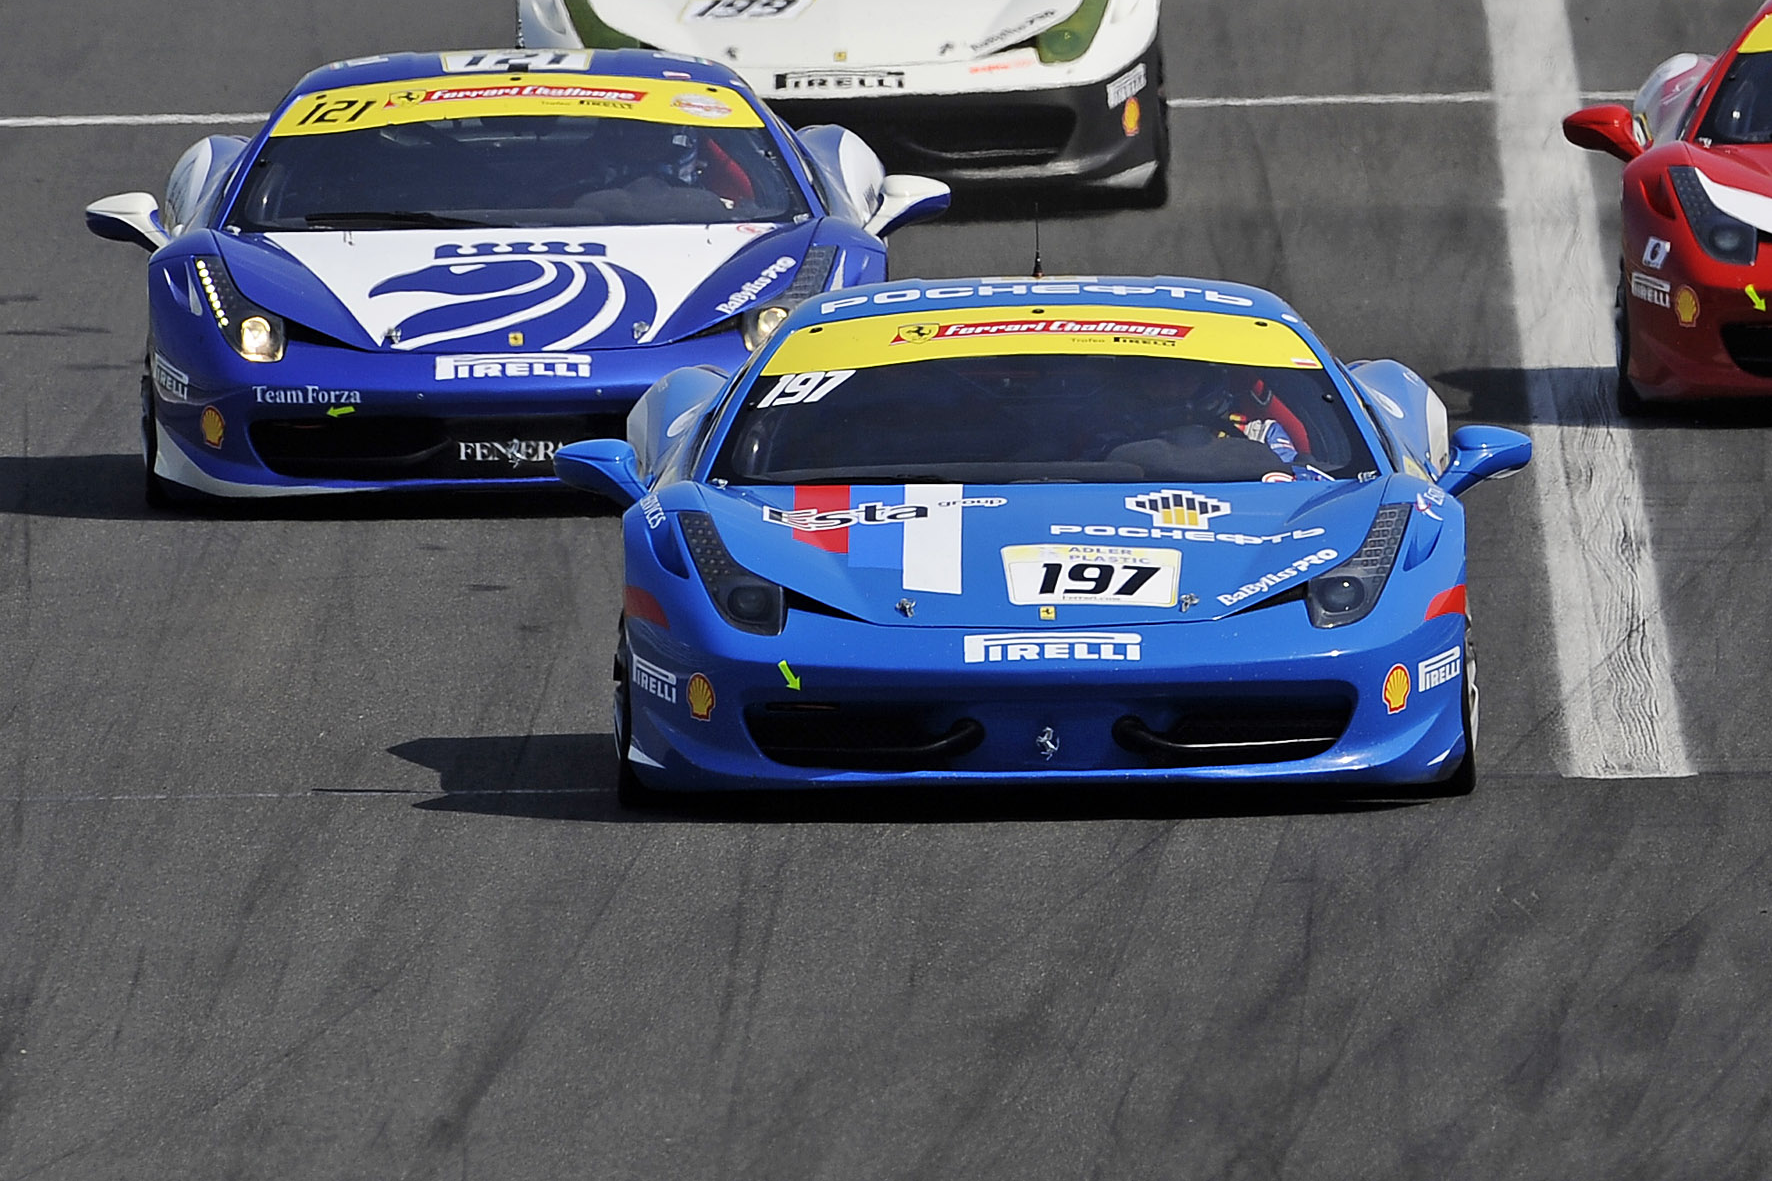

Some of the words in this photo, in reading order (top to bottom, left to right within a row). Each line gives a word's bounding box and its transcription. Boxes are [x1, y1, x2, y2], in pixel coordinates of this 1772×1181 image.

[430, 87, 520, 102] Ferrari
[521, 85, 637, 101] Challenge
[773, 68, 905, 91] PIRELLI
[296, 98, 377, 127] 121
[820, 283, 1254, 315] РОСНЕФТЬ
[944, 321, 1044, 337] Ferrari
[1048, 319, 1180, 337] Challenge
[1114, 336, 1177, 348] PIRELLI
[153, 351, 189, 401] PIRELLI
[434, 352, 593, 381] PIRELLI
[252, 385, 304, 404] Team
[305, 385, 362, 404] Forza
[757, 370, 858, 409] 197
[1050, 524, 1326, 546] РОСНЕФТЬ
[1068, 546, 1133, 555] ADLER
[1068, 554, 1151, 564] PLASTIC
[1038, 562, 1162, 596] 197
[963, 631, 1143, 664] PIRELLI
[632, 653, 678, 704] PIRELLI
[1417, 646, 1461, 693] PIRELLI
